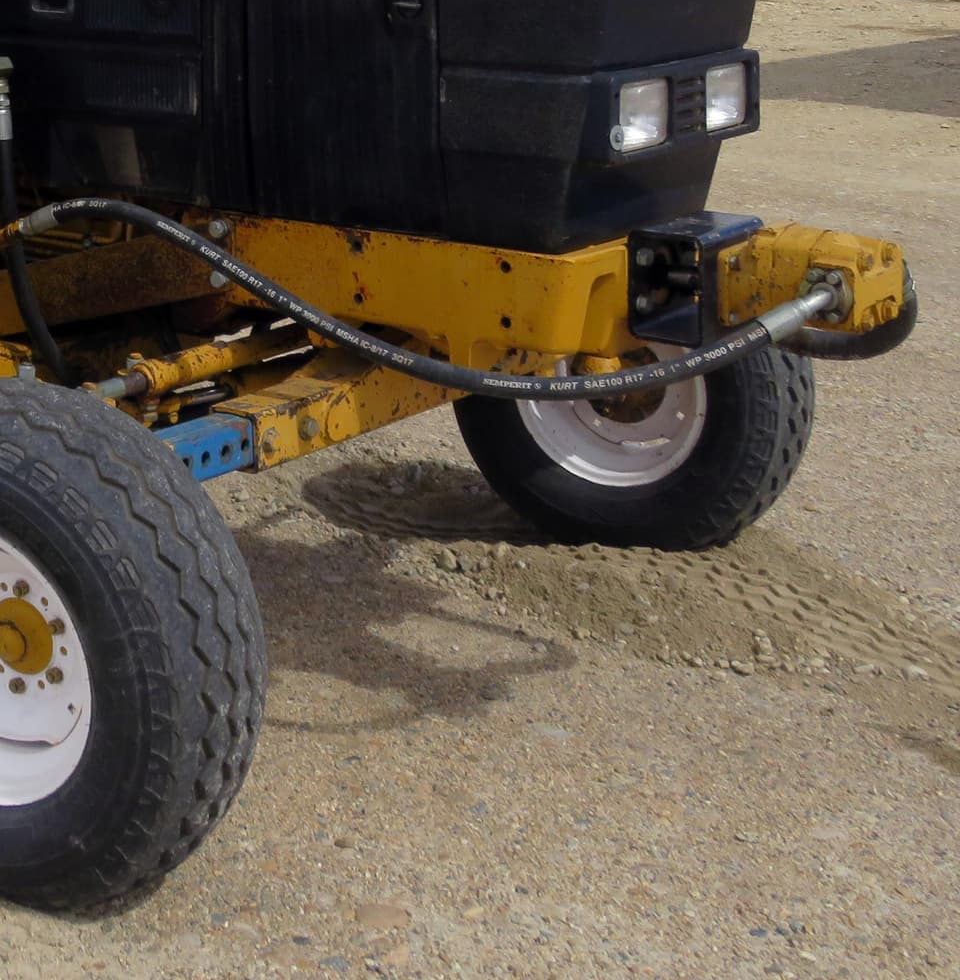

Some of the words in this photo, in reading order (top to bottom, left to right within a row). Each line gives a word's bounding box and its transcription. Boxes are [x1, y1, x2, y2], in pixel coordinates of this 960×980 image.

[200, 245, 221, 261] KURT
[221, 260, 249, 280] SAE100
[247, 276, 263, 288] R17
[289, 301, 303, 313] WP
[320, 320, 335, 332] PSI
[335, 328, 360, 346] MSHA
[482, 378, 533, 390] SEMPERIT
[549, 381, 579, 391] KURT
[583, 377, 622, 389] SAE100
[624, 373, 644, 385] R17
[685, 356, 703, 369] WP
[703, 347, 728, 362] 3000
[727, 338, 746, 352] PSI
